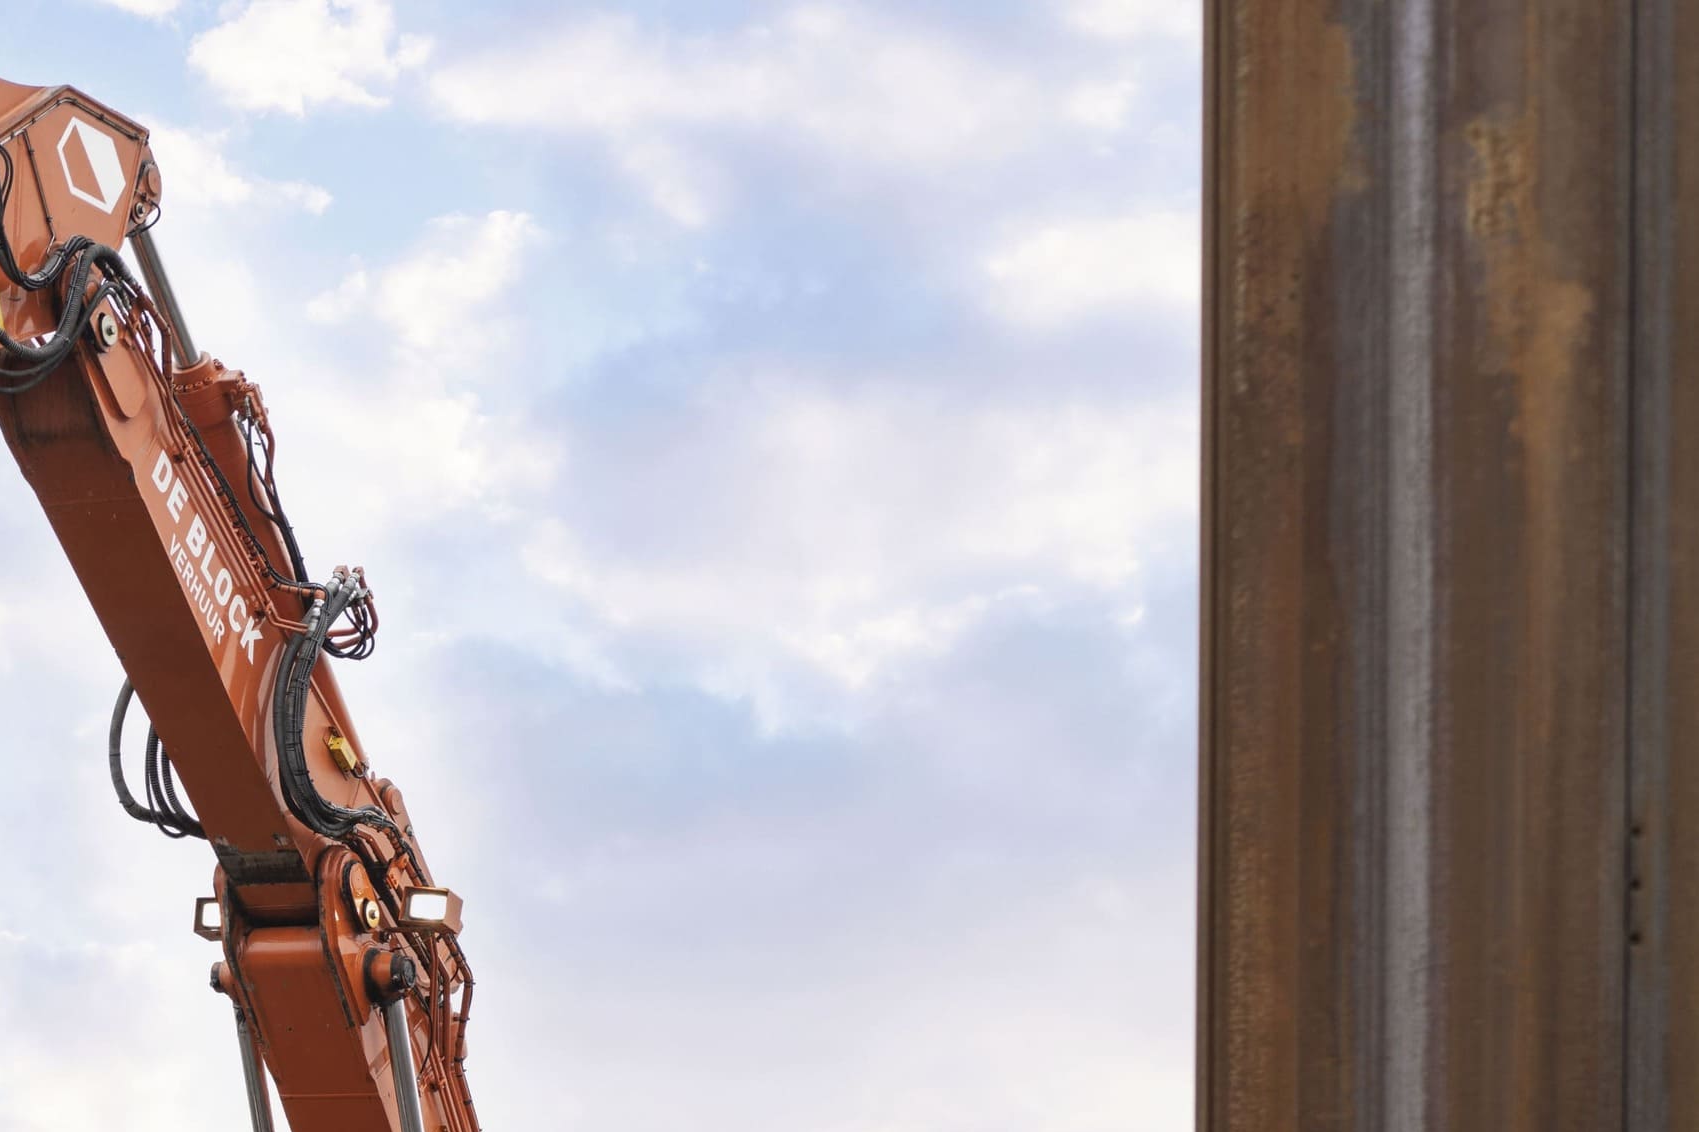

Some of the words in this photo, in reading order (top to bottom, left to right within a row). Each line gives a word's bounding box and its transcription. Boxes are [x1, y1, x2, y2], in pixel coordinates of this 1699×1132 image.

[152, 449, 189, 524] DE
[186, 513, 263, 665] BLOCK
[169, 533, 225, 645] VERHUUR
